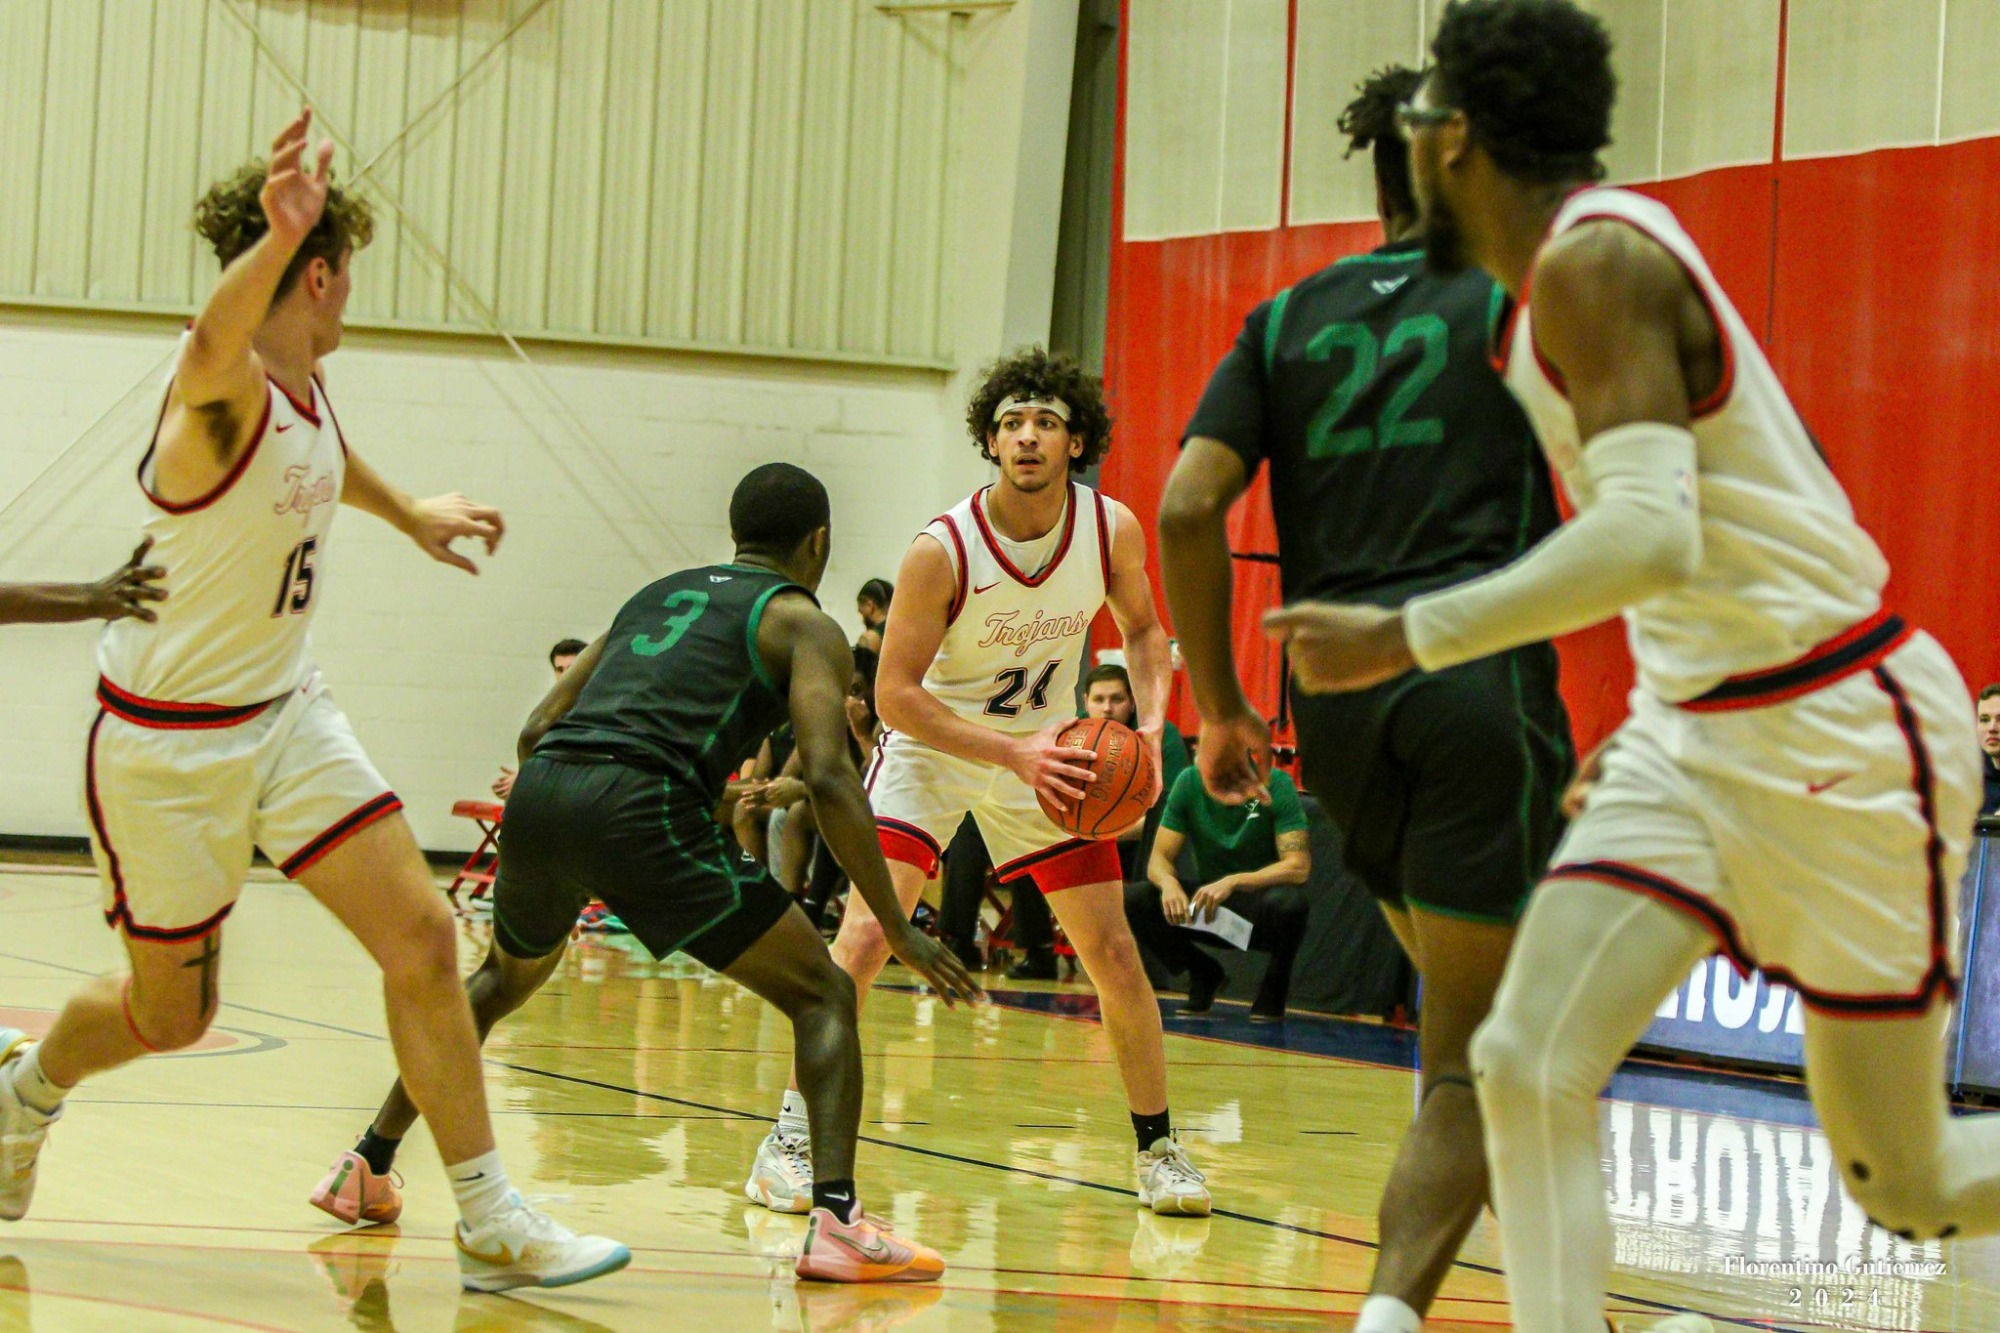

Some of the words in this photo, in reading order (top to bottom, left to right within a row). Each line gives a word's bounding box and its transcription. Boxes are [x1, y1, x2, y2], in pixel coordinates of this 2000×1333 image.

[1306, 314, 1449, 460] 22
[270, 534, 318, 618] 15
[630, 589, 710, 657] 3
[978, 609, 1089, 657] Trojans
